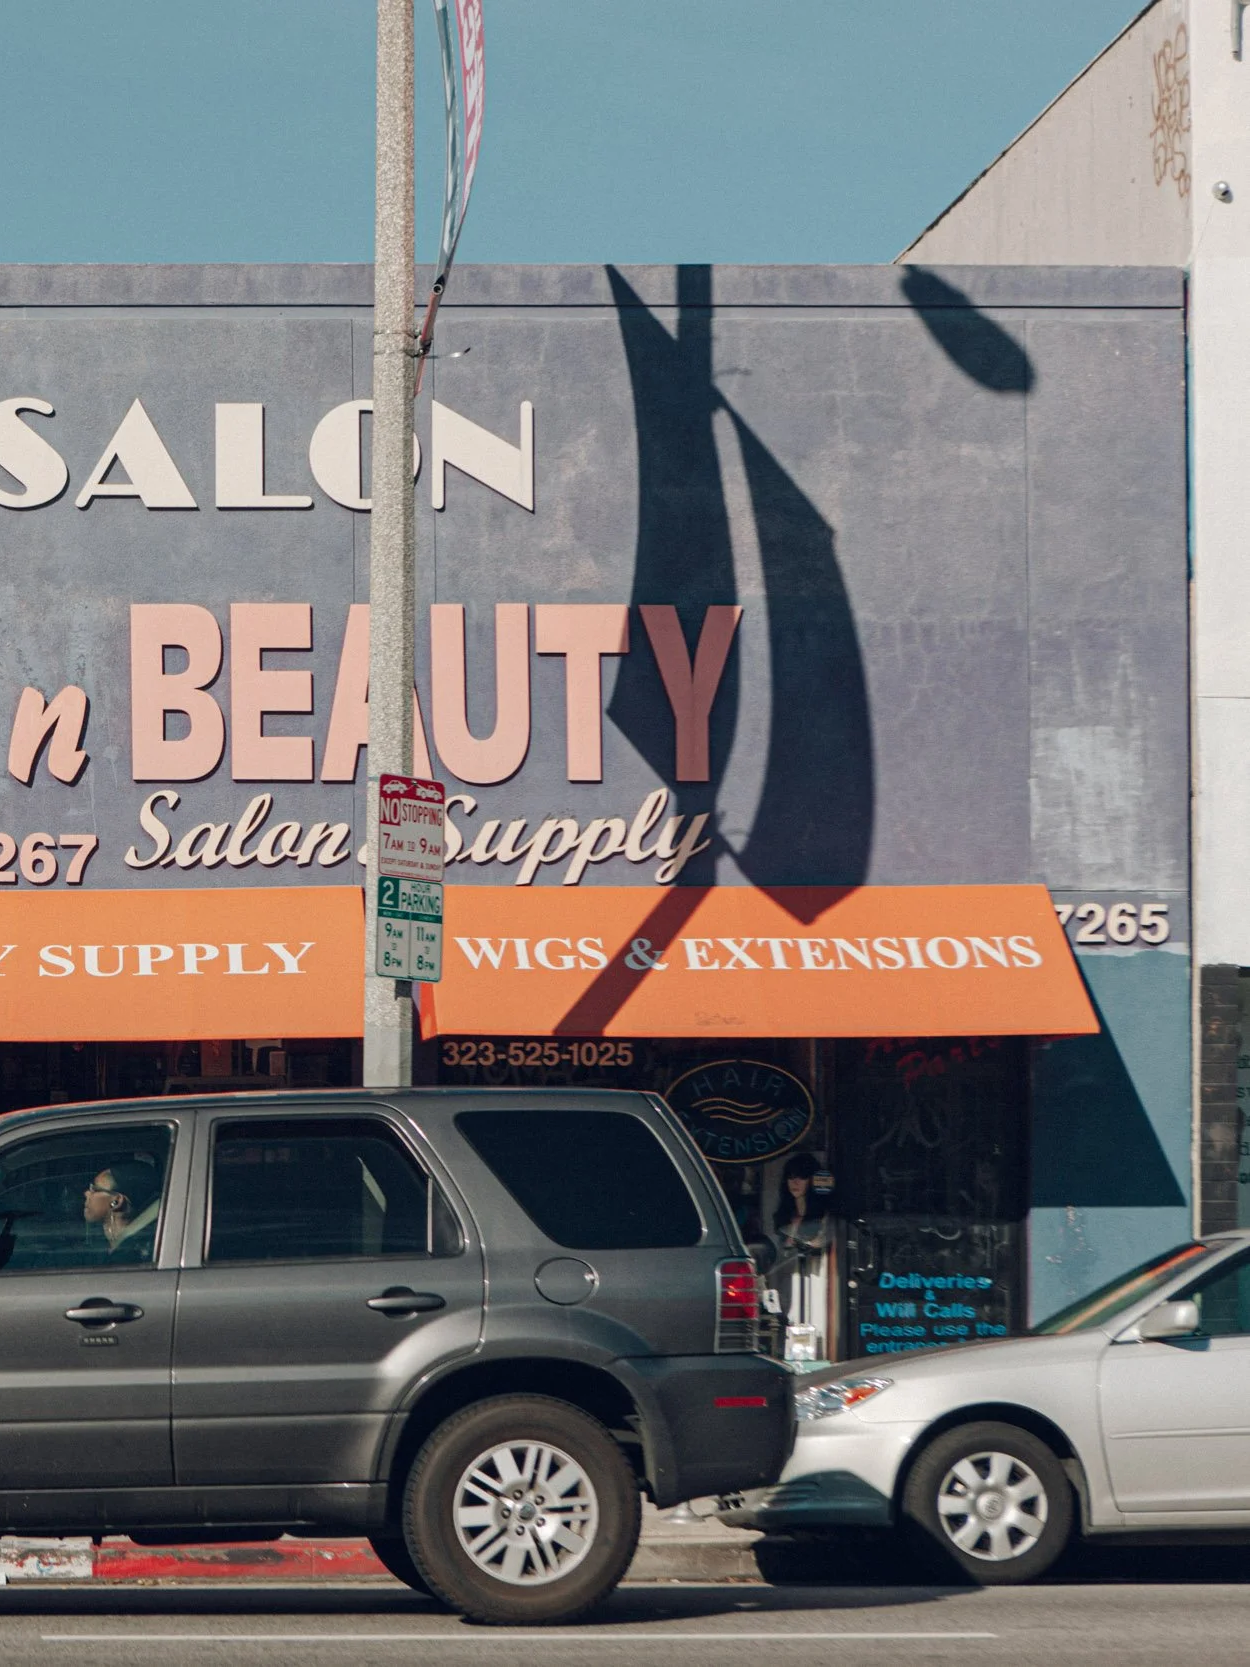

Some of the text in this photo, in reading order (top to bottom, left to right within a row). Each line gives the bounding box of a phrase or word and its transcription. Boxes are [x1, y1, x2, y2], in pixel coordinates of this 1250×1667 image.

[380, 797, 442, 826] NO STOPPING
[124, 790, 350, 868] Salon
[382, 880, 430, 905] 2 HOUR
[401, 892, 440, 914] PARKING
[38, 942, 316, 976] SUPPLY
[453, 935, 1044, 971] WIGS & EXTENSIONS
[442, 1041, 634, 1067] 323-525-1025
[691, 1067, 786, 1097] HAIR
[879, 1272, 992, 1289] Deliveries
[924, 1290, 935, 1301] &
[876, 1303, 977, 1318] Will Calls
[860, 1321, 1006, 1337] Please use the
